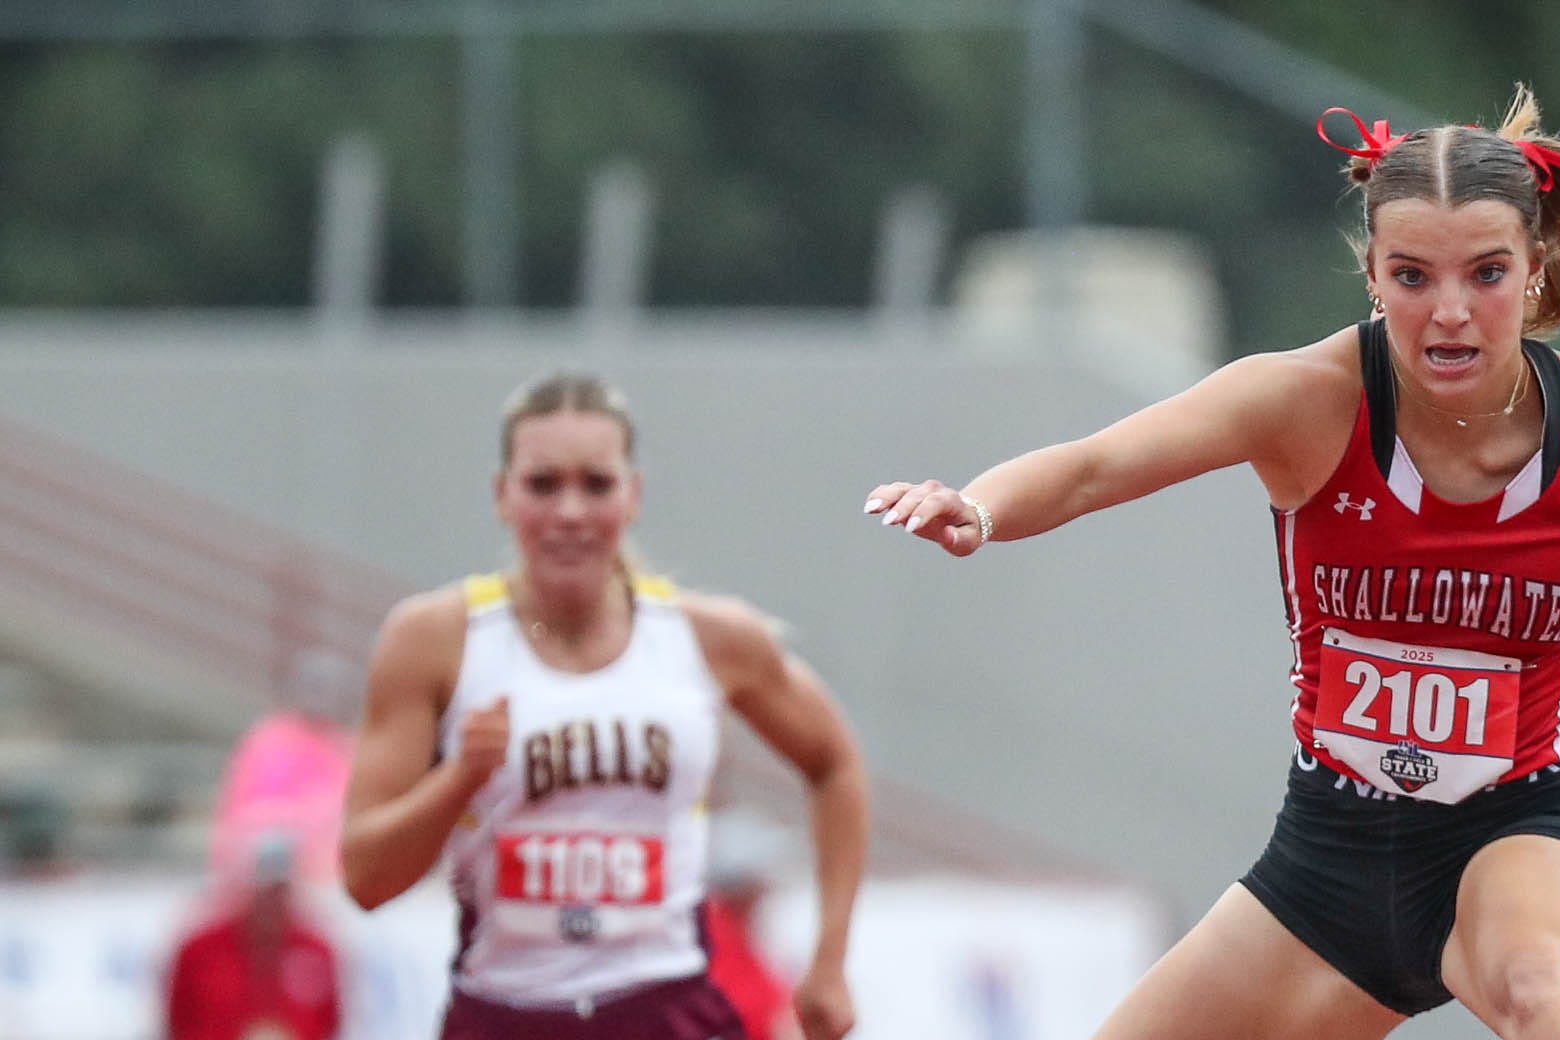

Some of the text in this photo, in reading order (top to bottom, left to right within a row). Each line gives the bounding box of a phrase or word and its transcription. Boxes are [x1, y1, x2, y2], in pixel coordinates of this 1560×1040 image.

[1400, 649, 1435, 662] 2025
[1342, 660, 1490, 746] 2101
[524, 719, 671, 801] BELLS
[1381, 757, 1437, 779] STATE
[514, 834, 648, 899] 1109
